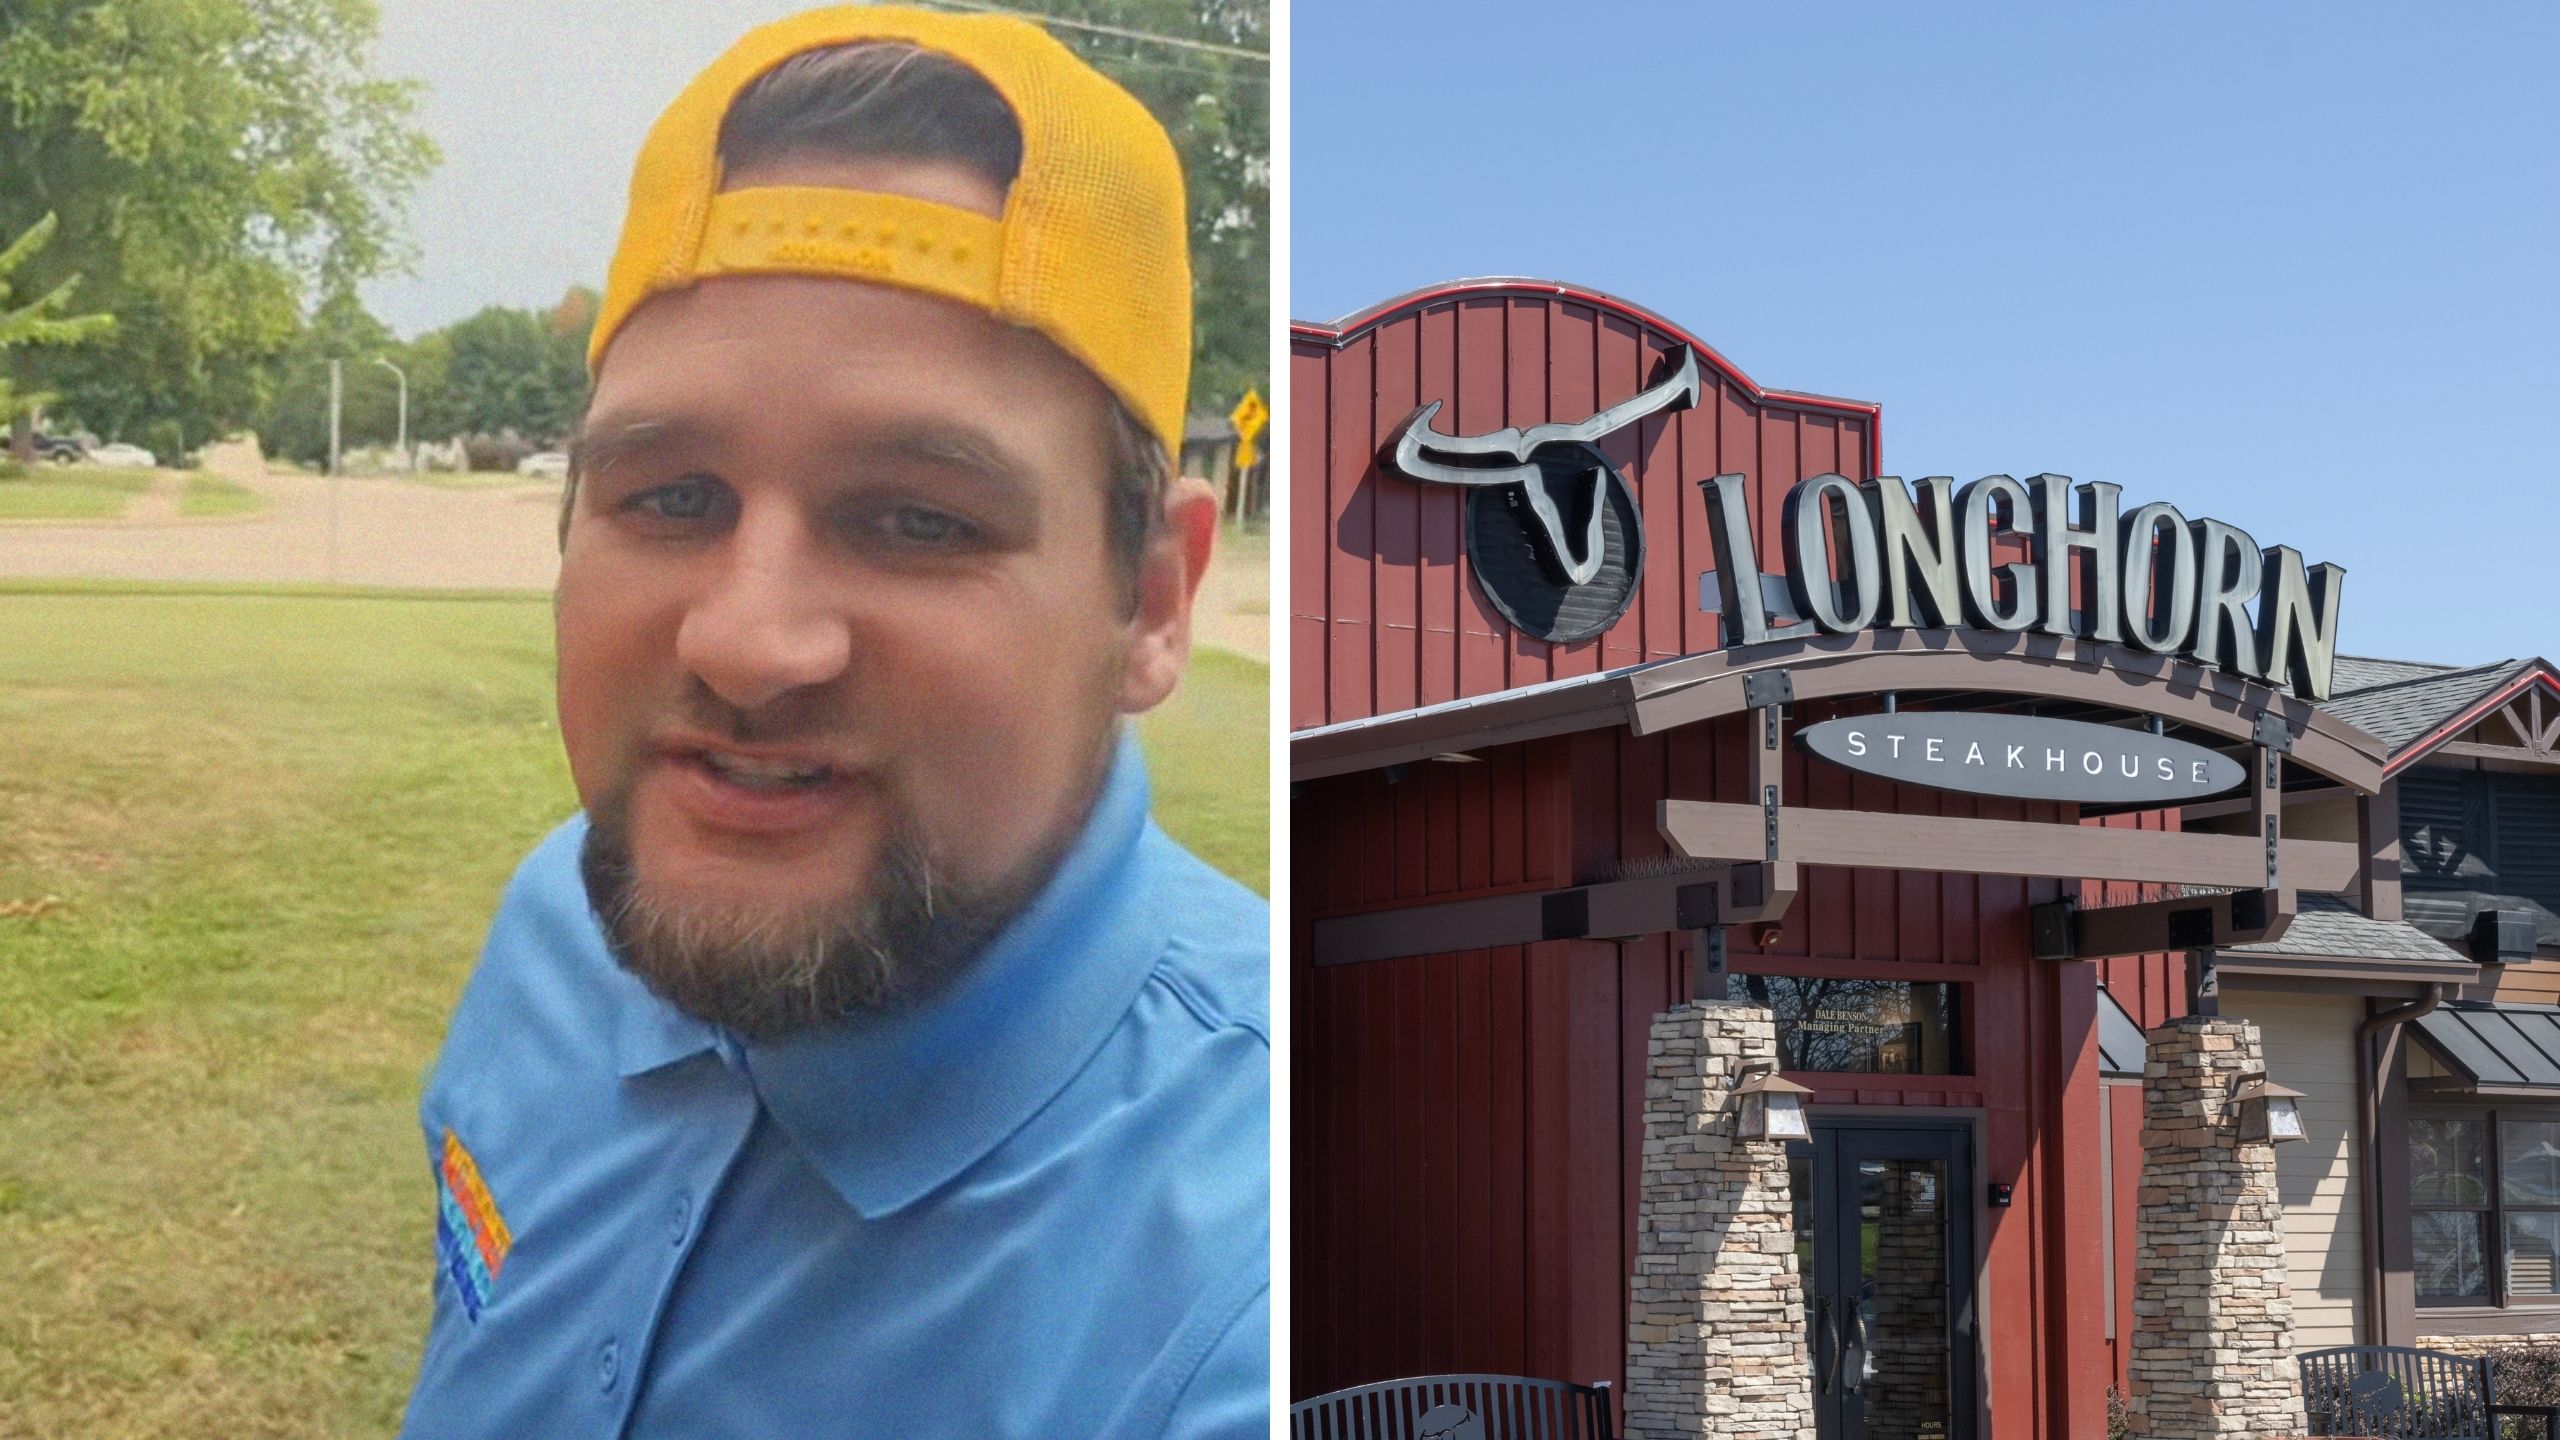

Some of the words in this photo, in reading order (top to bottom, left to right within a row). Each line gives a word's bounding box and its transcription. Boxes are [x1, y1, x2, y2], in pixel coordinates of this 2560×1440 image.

[1698, 472, 2347, 702] LONGHORN
[1847, 731, 2210, 784] STEAKHOUSE
[1815, 1009, 1836, 1020] DALE
[1837, 1010, 1867, 1021] BENSON
[1797, 1020, 1845, 1034] Managing
[1848, 1023, 1884, 1034] Partner
[1920, 1421, 1942, 1429] HOURS
